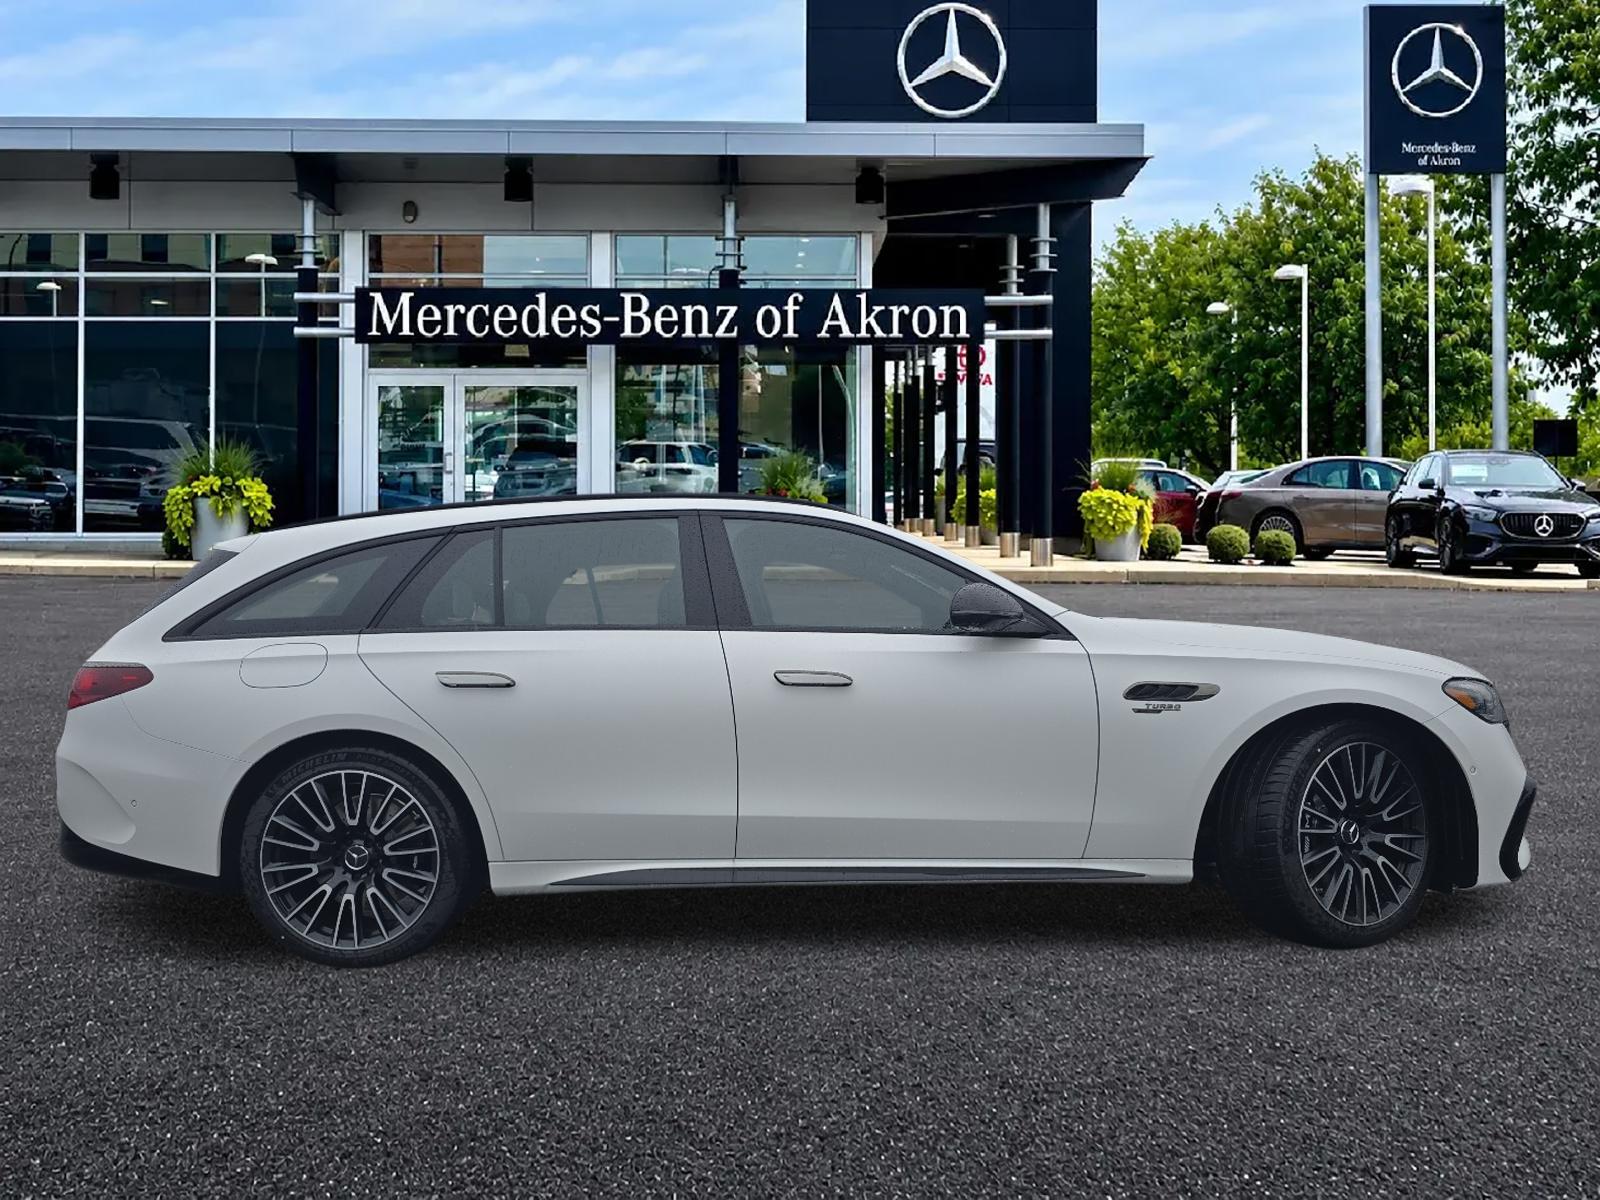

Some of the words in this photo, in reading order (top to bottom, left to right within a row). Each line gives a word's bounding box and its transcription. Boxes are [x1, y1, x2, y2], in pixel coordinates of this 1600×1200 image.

[1401, 141, 1477, 153] Mercedes-Benz
[1418, 154, 1428, 166] of
[1430, 154, 1461, 166] Akron
[368, 291, 738, 339] Mercedes-Benz
[755, 291, 804, 339] of
[816, 291, 971, 339] Akron
[281, 752, 347, 784] MICHELIN
